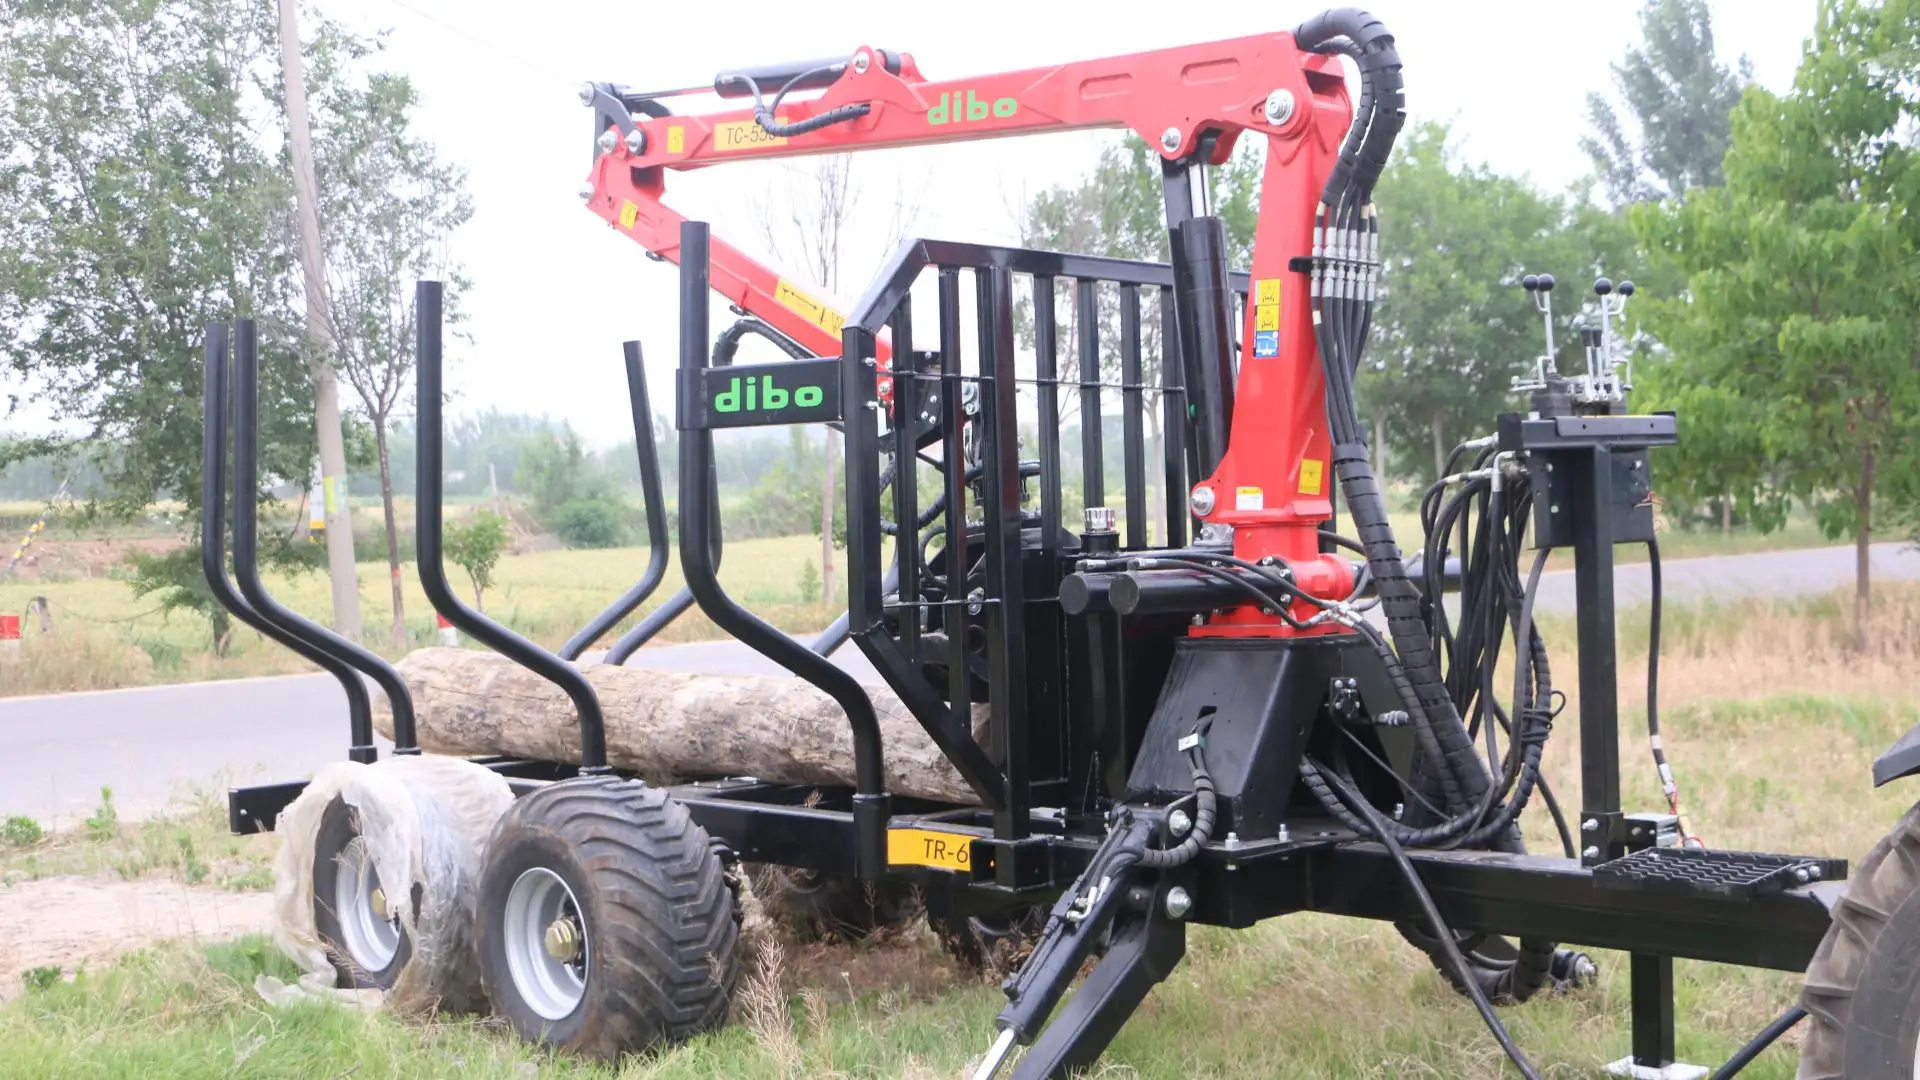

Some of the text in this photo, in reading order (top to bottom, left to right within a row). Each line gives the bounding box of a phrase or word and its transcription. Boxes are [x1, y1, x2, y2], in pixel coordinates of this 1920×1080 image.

[928, 89, 1018, 125] dibo
[715, 375, 823, 412] dibo
[923, 838, 969, 864] TR-6
